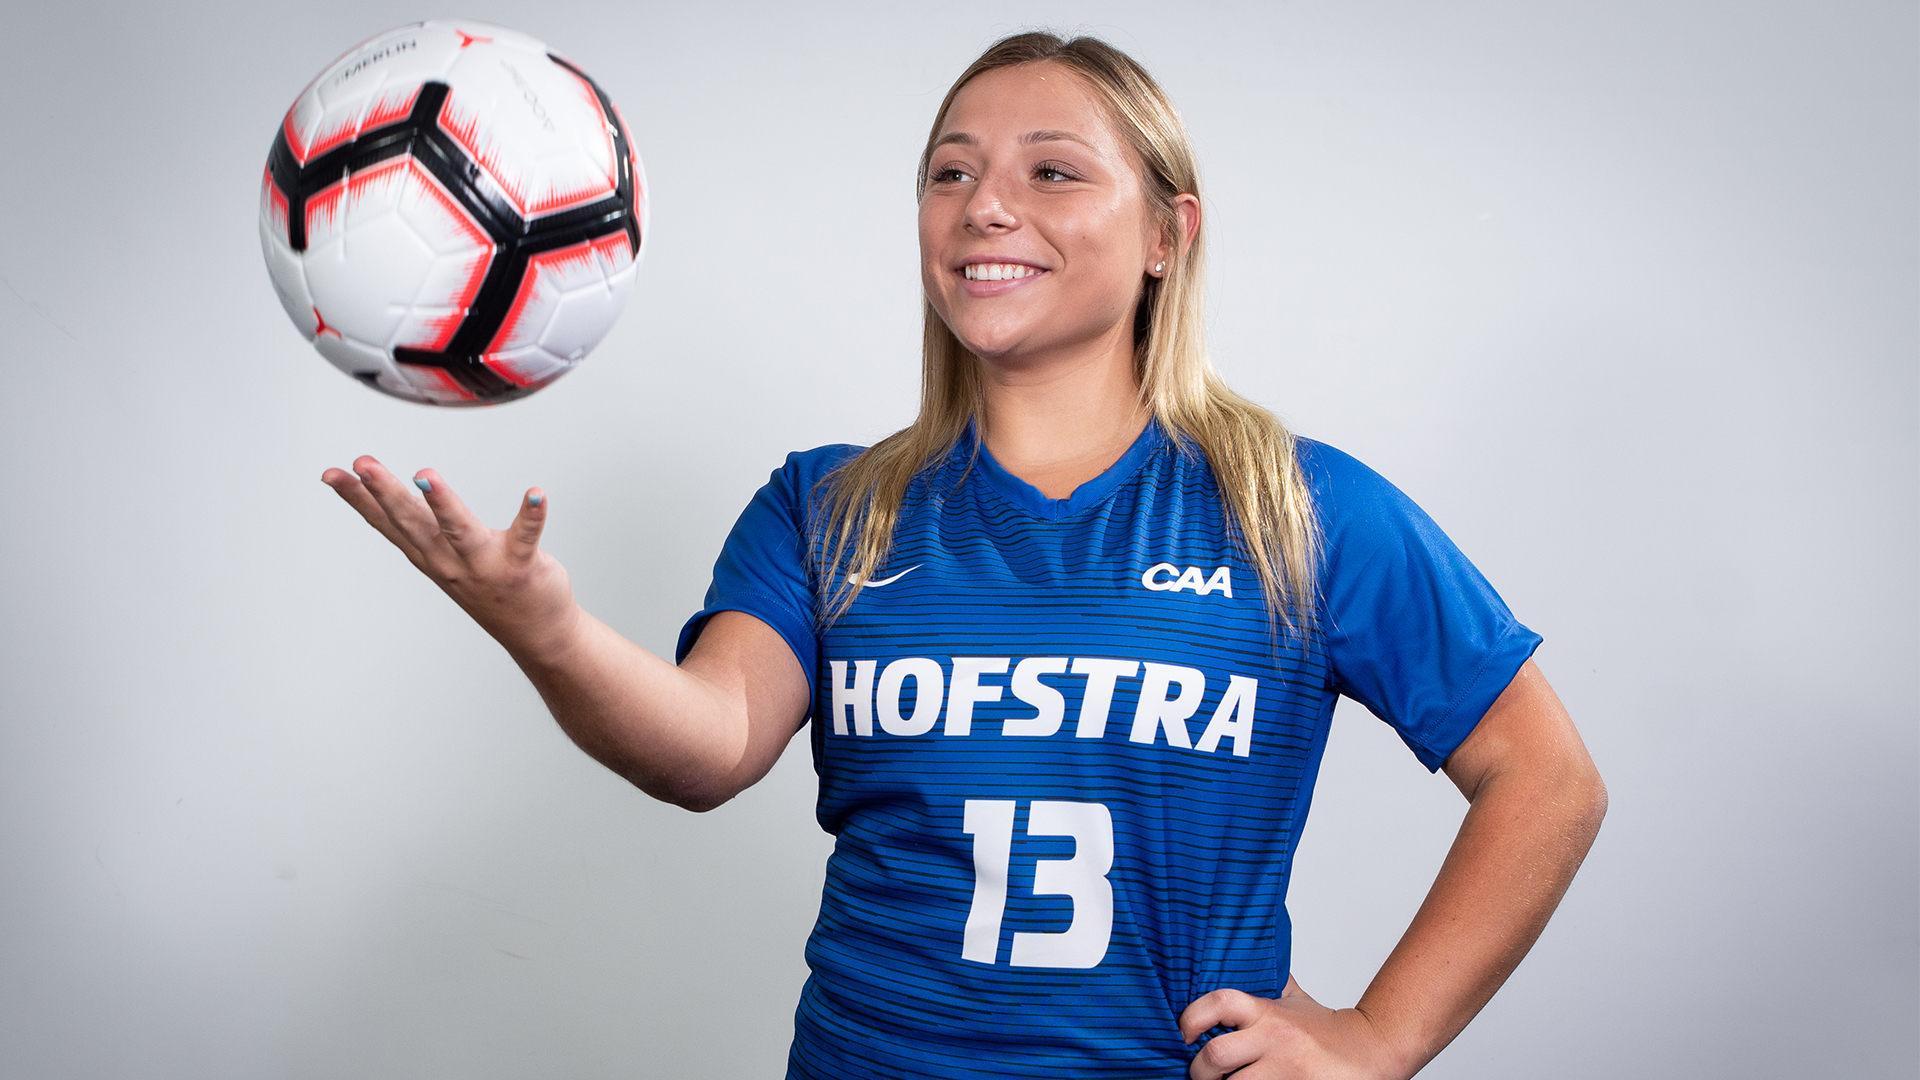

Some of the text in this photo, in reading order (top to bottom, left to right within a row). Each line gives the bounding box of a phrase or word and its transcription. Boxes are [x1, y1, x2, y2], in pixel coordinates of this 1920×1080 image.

[345, 38, 416, 79] MERLIN
[1141, 563, 1233, 598] CAA
[829, 657, 1258, 757] HOFSTRA
[961, 800, 1115, 969] 13
